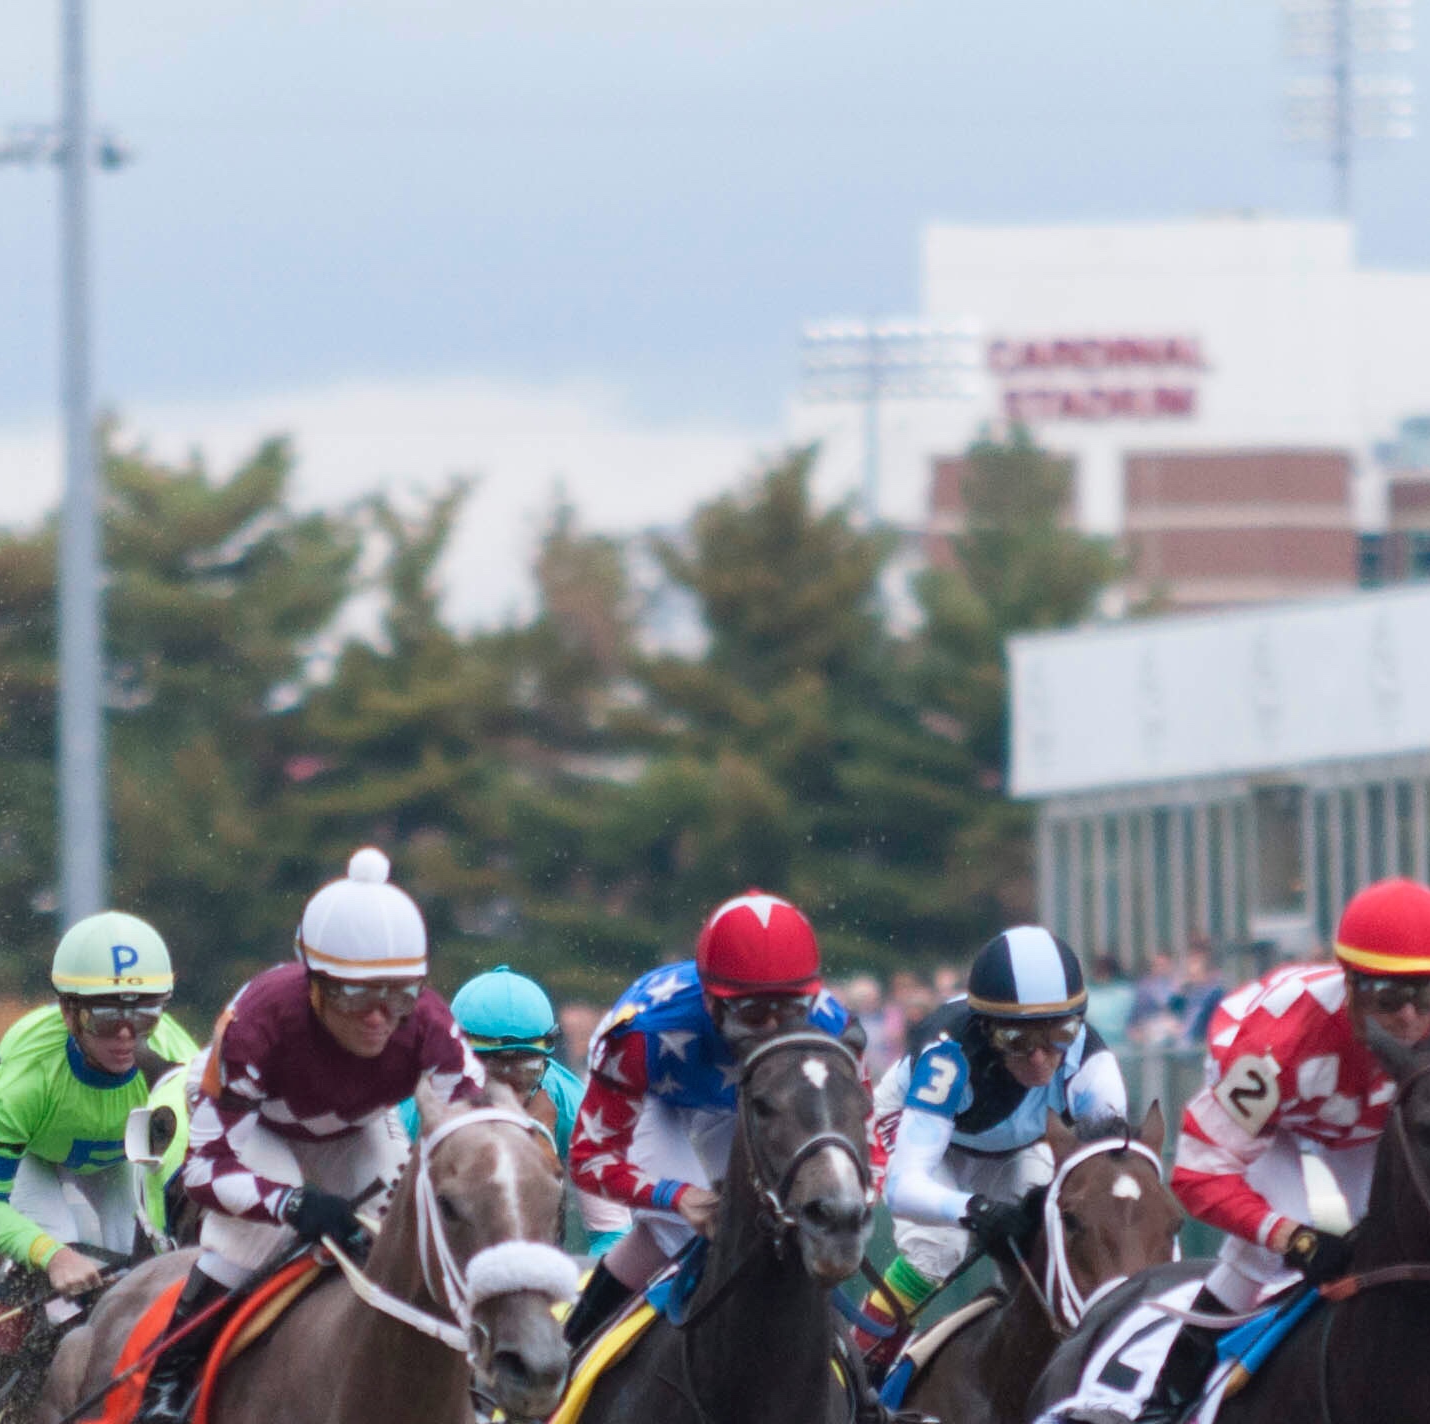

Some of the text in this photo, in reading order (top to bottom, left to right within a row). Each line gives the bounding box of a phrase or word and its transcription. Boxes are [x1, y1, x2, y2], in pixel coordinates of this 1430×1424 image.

[110, 945, 139, 977] P
[916, 1056, 959, 1106] 3
[1229, 1068, 1268, 1119] 2
